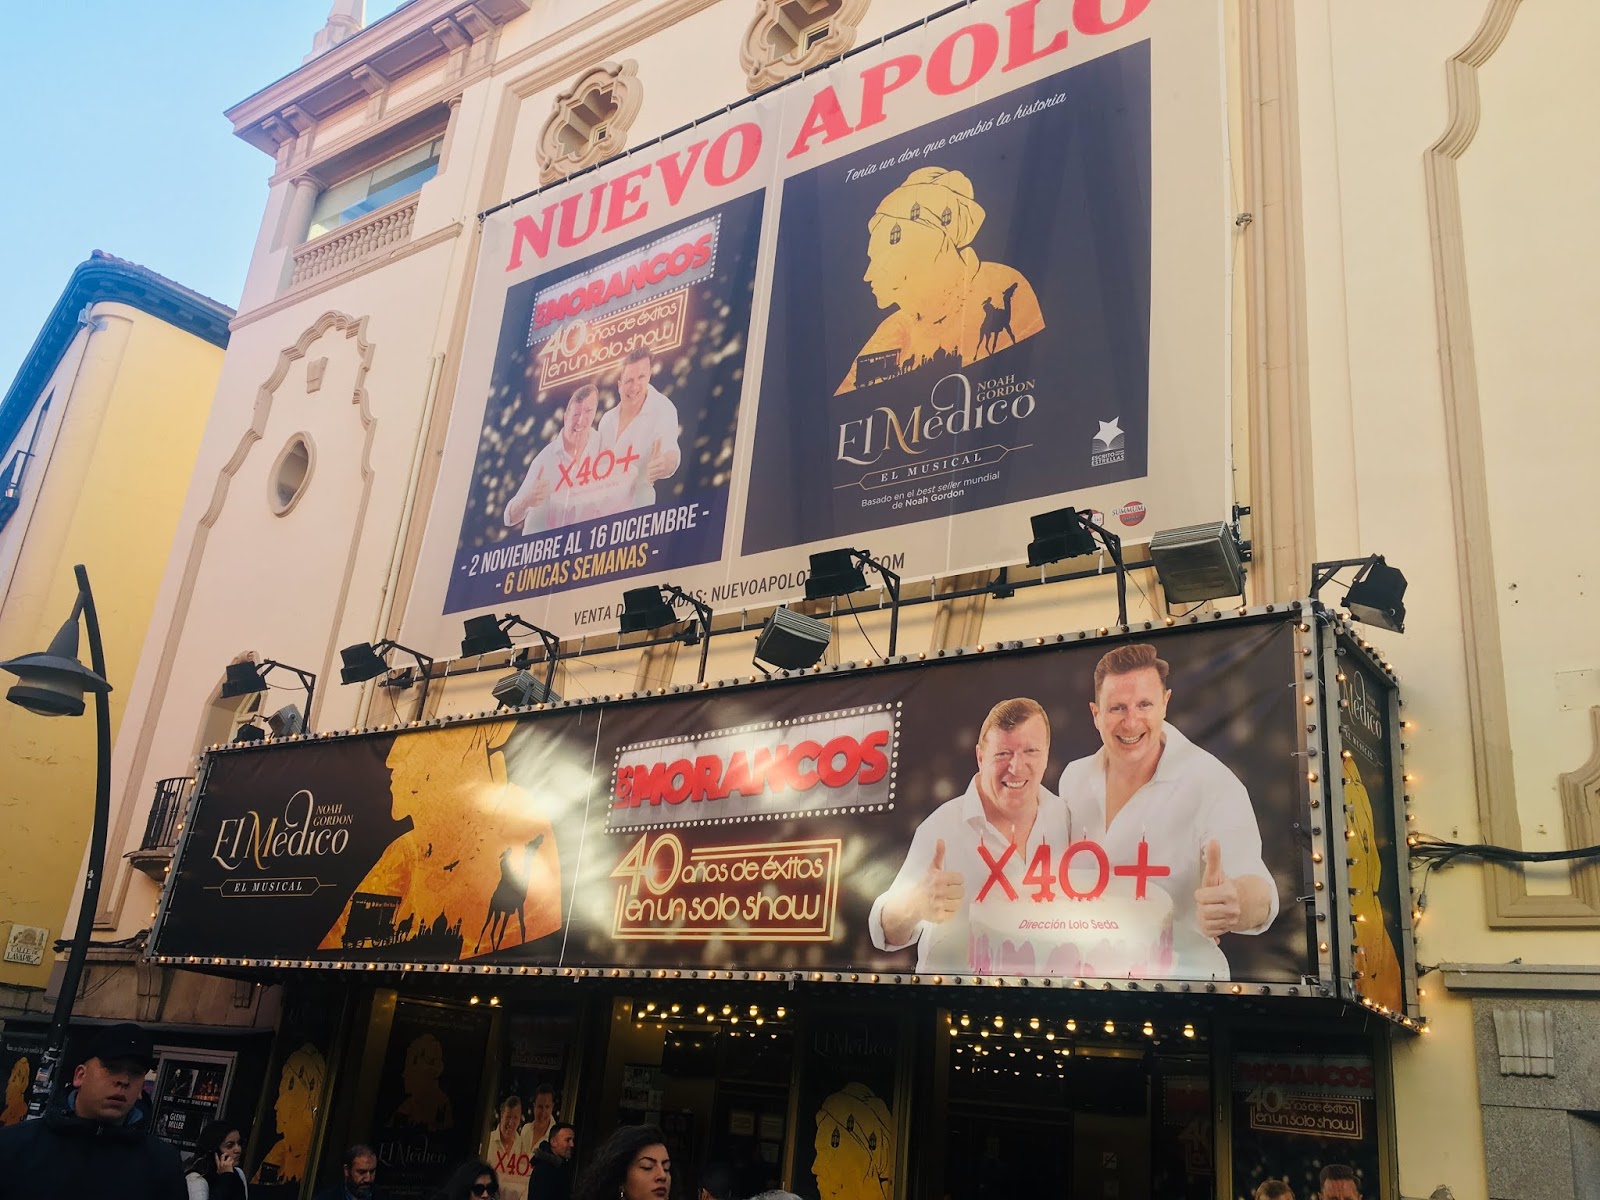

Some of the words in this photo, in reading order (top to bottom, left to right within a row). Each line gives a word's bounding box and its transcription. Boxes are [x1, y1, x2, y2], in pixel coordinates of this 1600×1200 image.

[845, 163, 878, 183] Tenía
[879, 158, 896, 171] un
[897, 147, 921, 164] don
[922, 138, 946, 158] que
[948, 119, 993, 145] cambió
[996, 111, 1012, 127] la
[1013, 92, 1067, 120] historia
[505, 121, 762, 272] NUEVO
[544, 233, 713, 326] MORANCOS
[537, 318, 587, 363] 40
[617, 317, 636, 334] de
[638, 301, 678, 326] éxitos
[589, 340, 623, 365] solo
[624, 321, 675, 353] show
[976, 379, 1036, 403] GORDON
[977, 374, 1016, 392] NOAH
[836, 414, 885, 466] El
[874, 373, 1036, 455] Médico
[555, 445, 640, 492] X40+
[880, 473, 899, 483] EL
[907, 453, 982, 478] MUSICAL
[861, 494, 893, 507] Basado
[894, 493, 905, 501] en
[906, 490, 915, 499] el
[916, 485, 935, 496] best
[937, 479, 961, 493] seller
[963, 471, 1000, 487] mundial
[891, 501, 903, 510] de
[905, 496, 929, 507] Noah
[930, 489, 965, 502] Gordon
[468, 554, 480, 578] 2
[480, 535, 563, 574] NOVIEMBRE
[564, 530, 583, 556] AL
[589, 526, 606, 551] 16
[610, 503, 699, 546] DICIEMBRE
[503, 572, 515, 595] 6
[516, 559, 570, 593] ÚNICAS
[572, 542, 649, 581] SEMANAS
[574, 605, 612, 626] VENTA
[630, 729, 889, 808] MORANCOS
[313, 814, 353, 827] GORDON
[316, 804, 343, 815] NOAH
[211, 817, 246, 870] El
[243, 789, 349, 870] Médico
[610, 832, 683, 896] 40
[681, 862, 727, 883] años
[730, 858, 760, 880] de
[761, 855, 824, 880] éxitos
[975, 838, 1171, 903] X40+
[234, 882, 247, 892] EL
[252, 881, 303, 892] MUSICAL
[625, 904, 655, 921] en
[657, 902, 686, 921] un
[688, 892, 739, 921] solo
[742, 891, 820, 921] show
[1018, 919, 1066, 930] Dirección
[1068, 919, 1089, 930] Lolo
[1092, 919, 1120, 930] Seda
[1244, 1084, 1283, 1113] 40
[1290, 1113, 1315, 1127] solo
[1316, 1115, 1355, 1130] show
[494, 1151, 535, 1176] X40
